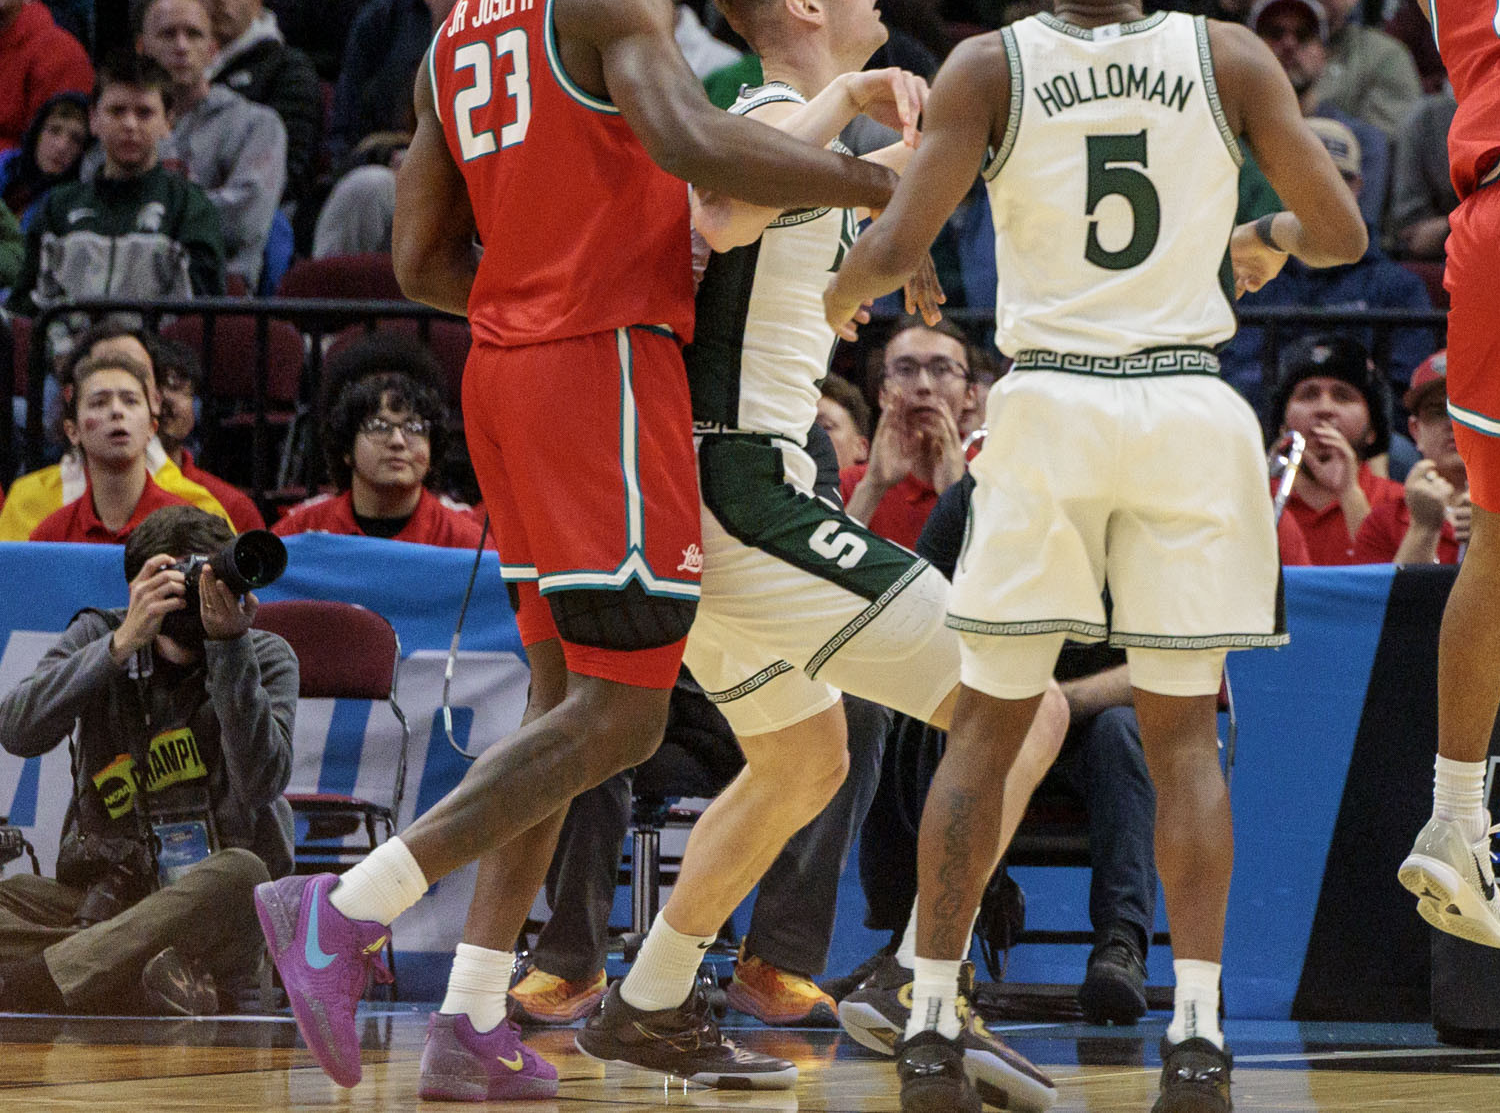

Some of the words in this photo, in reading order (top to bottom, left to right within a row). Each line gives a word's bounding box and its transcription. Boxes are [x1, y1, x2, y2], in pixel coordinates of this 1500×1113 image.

[454, 27, 532, 163] 23
[1033, 64, 1194, 117] HOLLOMAN
[1084, 129, 1161, 271] 5
[809, 520, 869, 569] S
